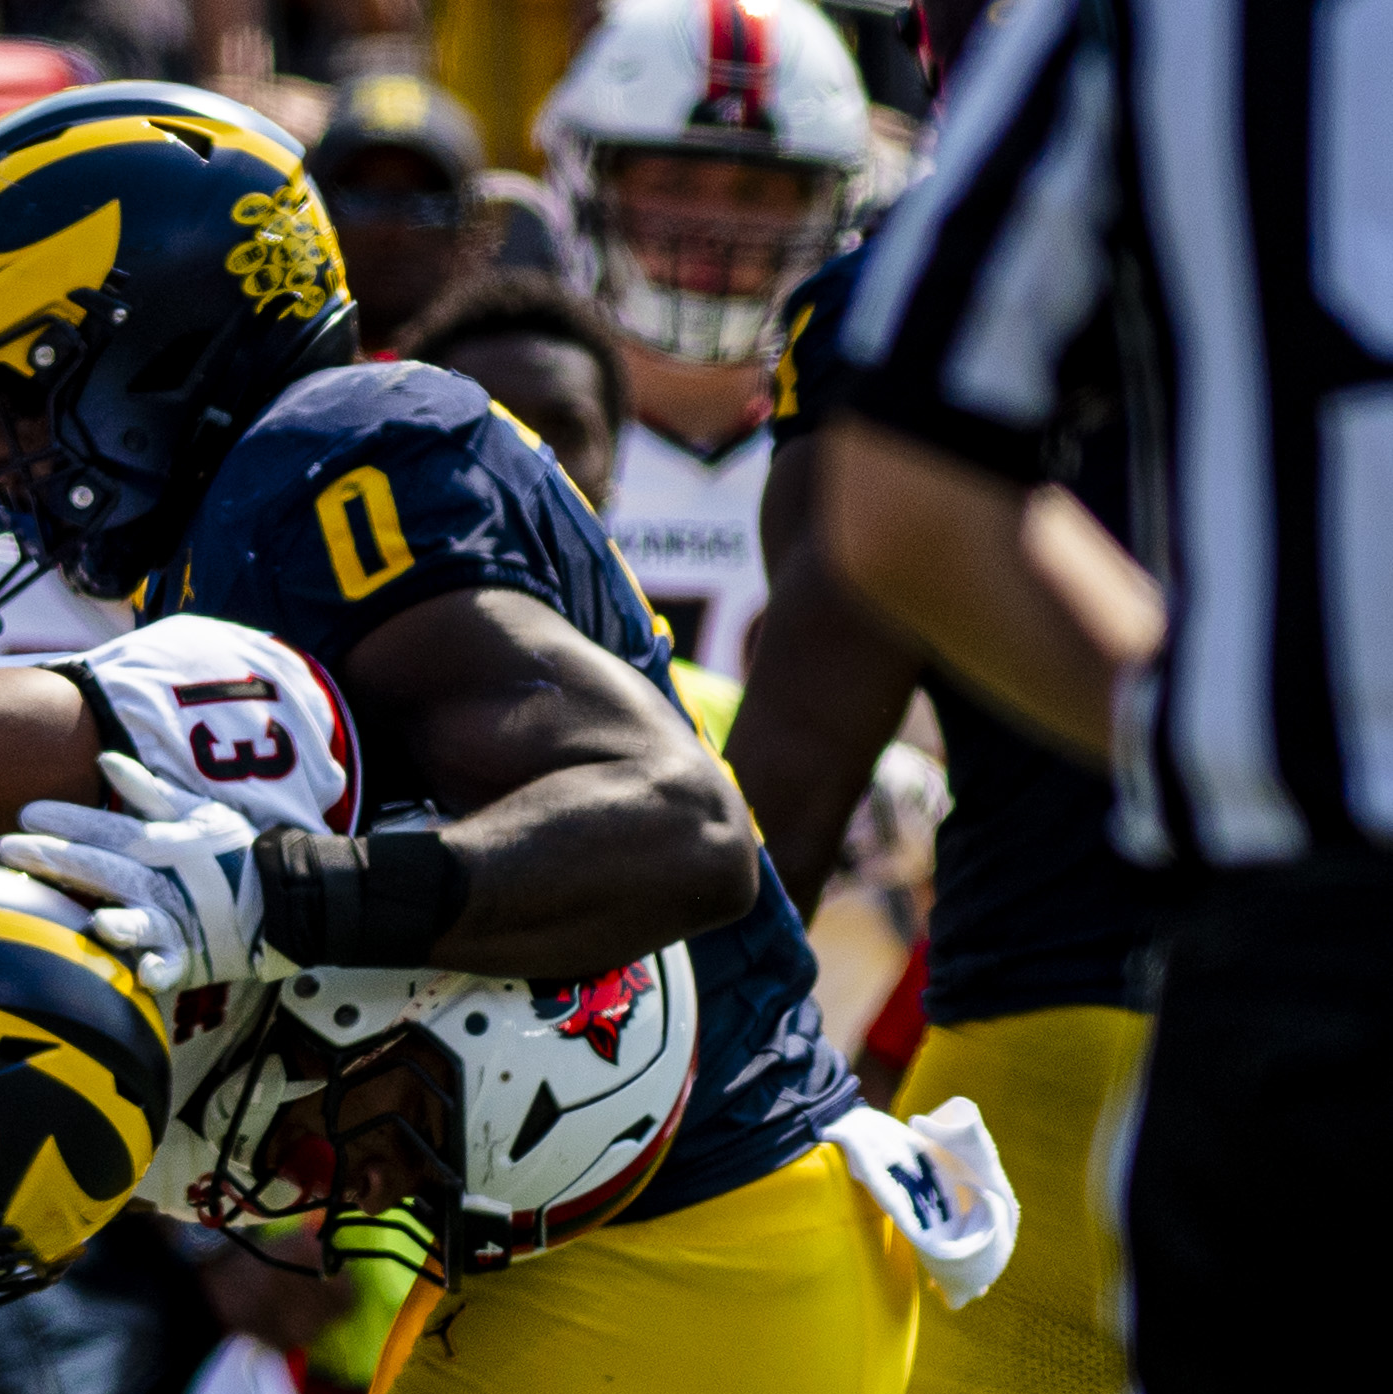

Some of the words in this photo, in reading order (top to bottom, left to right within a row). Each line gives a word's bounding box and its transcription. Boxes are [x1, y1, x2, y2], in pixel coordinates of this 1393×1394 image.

[315, 464, 415, 602] 0
[171, 671, 298, 782] 13
[886, 1151, 951, 1231] M
